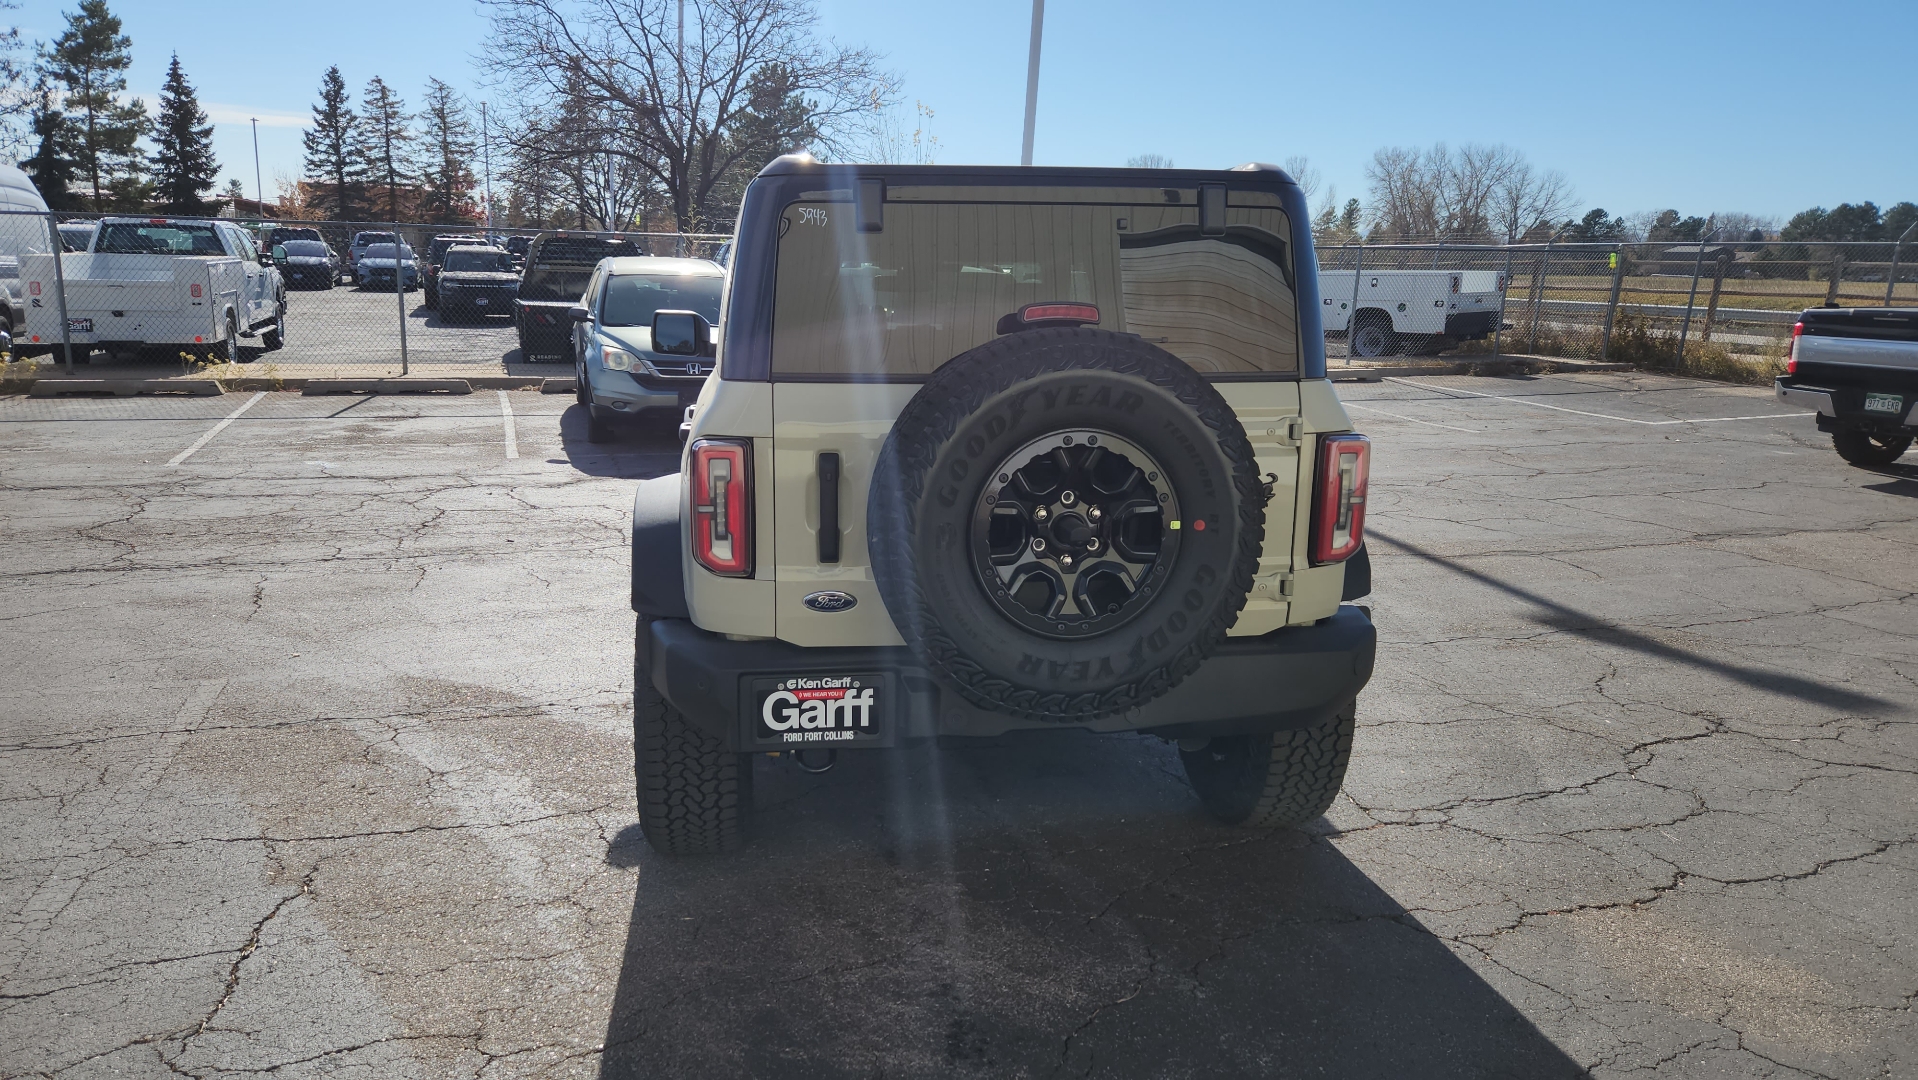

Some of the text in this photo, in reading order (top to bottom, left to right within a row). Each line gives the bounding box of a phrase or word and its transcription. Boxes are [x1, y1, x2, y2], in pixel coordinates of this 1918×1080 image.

[798, 207, 828, 227] 5943
[815, 595, 845, 608] Ford
[797, 676, 852, 689] Ken Garff
[762, 688, 874, 731] Garff
[783, 730, 854, 742] FORD FORT COLLINS
